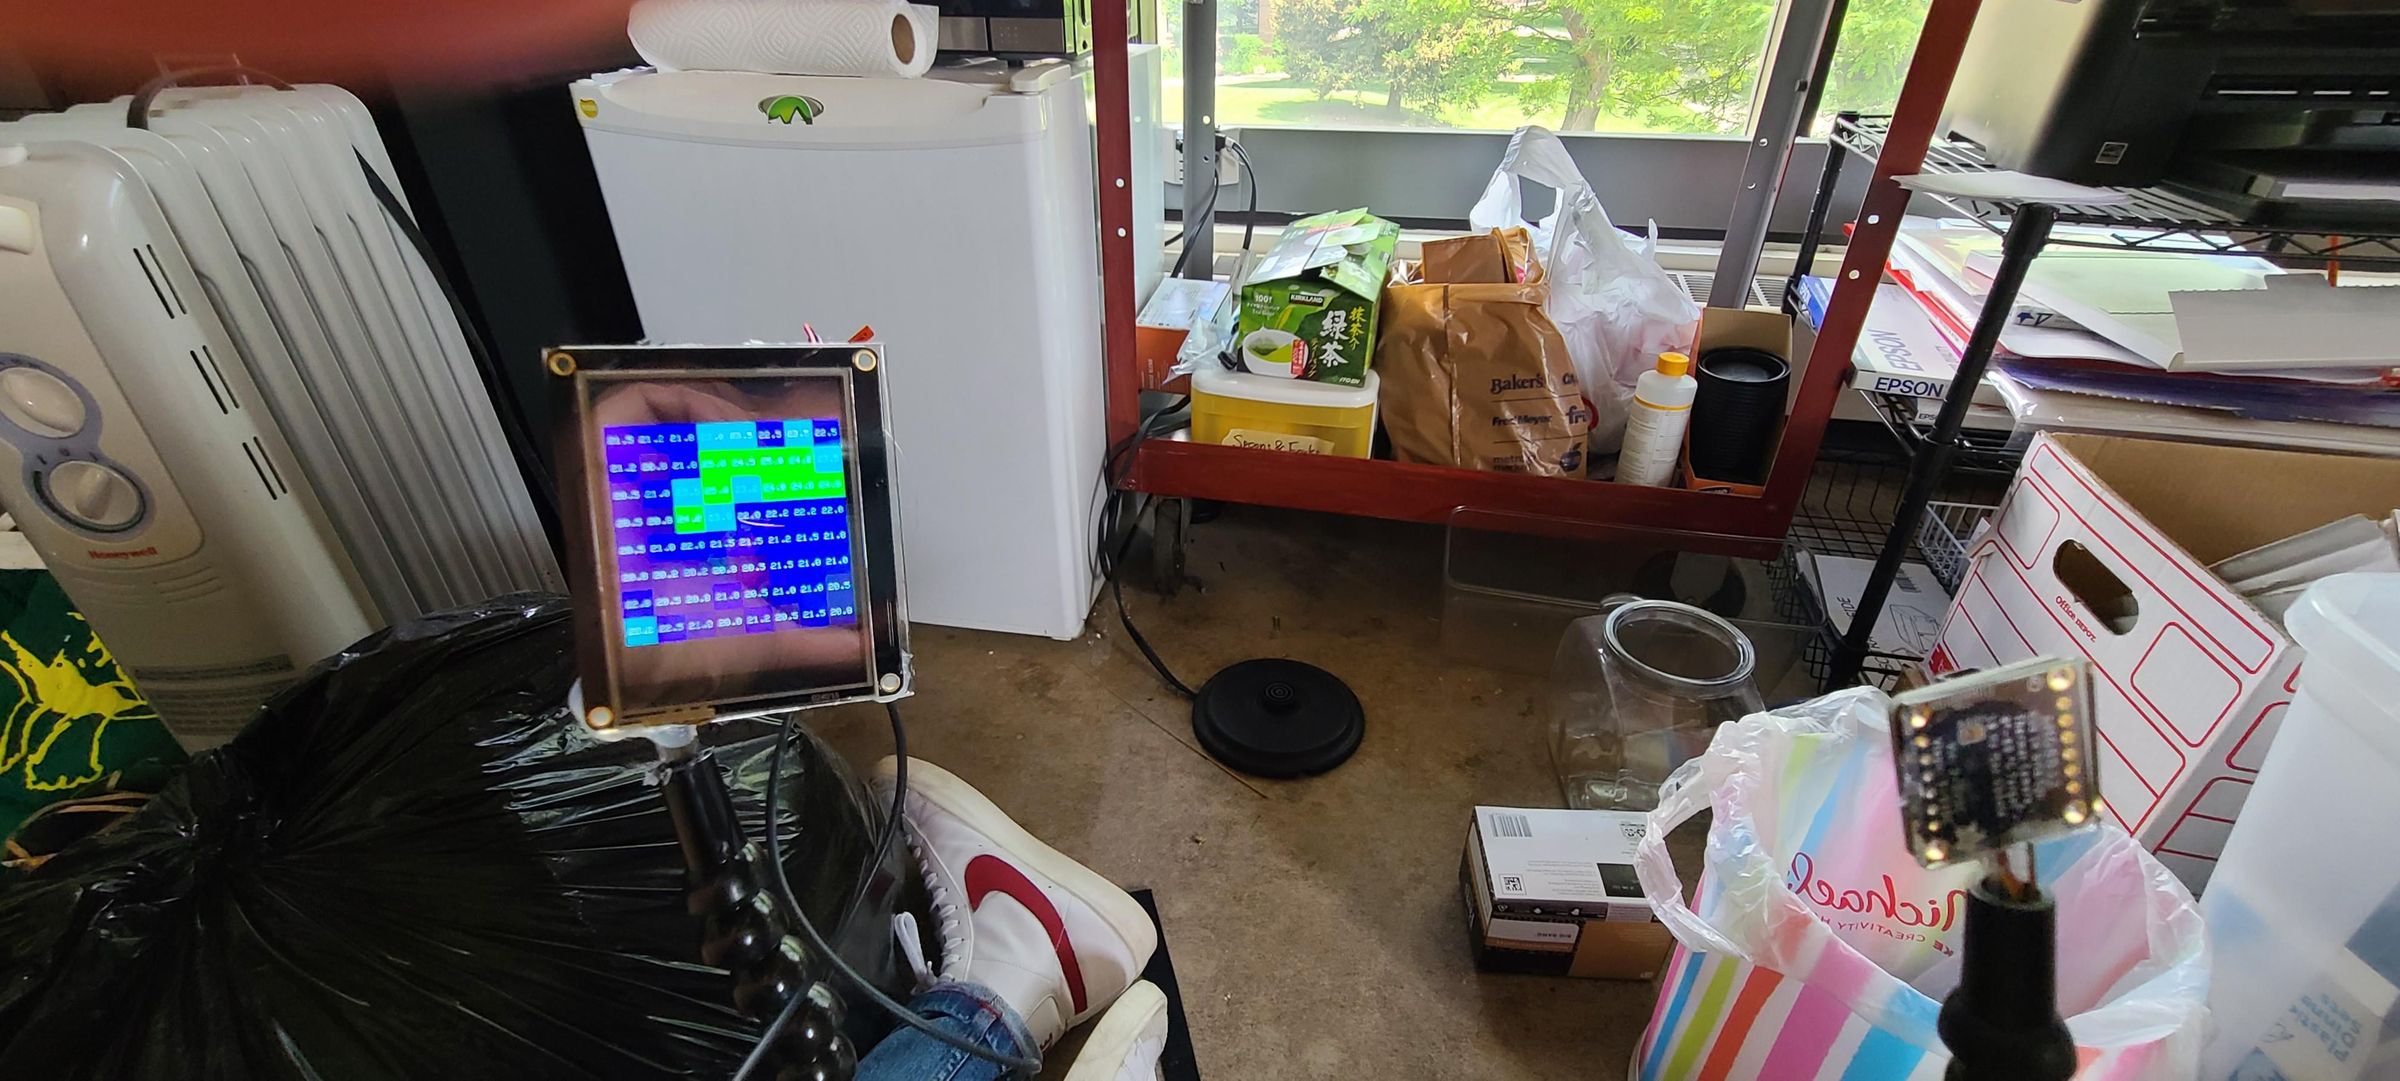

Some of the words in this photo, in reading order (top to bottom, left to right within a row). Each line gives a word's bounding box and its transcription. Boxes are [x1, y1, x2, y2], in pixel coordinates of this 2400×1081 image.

[1319, 309, 1350, 368] 緑茶
[1867, 329, 1924, 372] EPSON
[1490, 374, 1546, 394] Baker's
[1874, 376, 1944, 398] EPSON
[1918, 413, 1935, 421] EPS
[757, 428, 782, 439] 22.5
[813, 426, 838, 436] 22.5
[764, 508, 789, 518] 22.2
[792, 506, 817, 516] 22.2
[708, 538, 734, 549] 21.5
[738, 536, 763, 546] 21.5
[766, 534, 791, 544] 21.2
[795, 532, 819, 542] 21.5
[87, 546, 159, 560] Honeywell
[769, 559, 793, 570] 21.5
[827, 580, 850, 591] 20.5
[2055, 595, 2076, 620] Office
[745, 614, 770, 624] 21.2
[801, 608, 825, 619] 21.5
